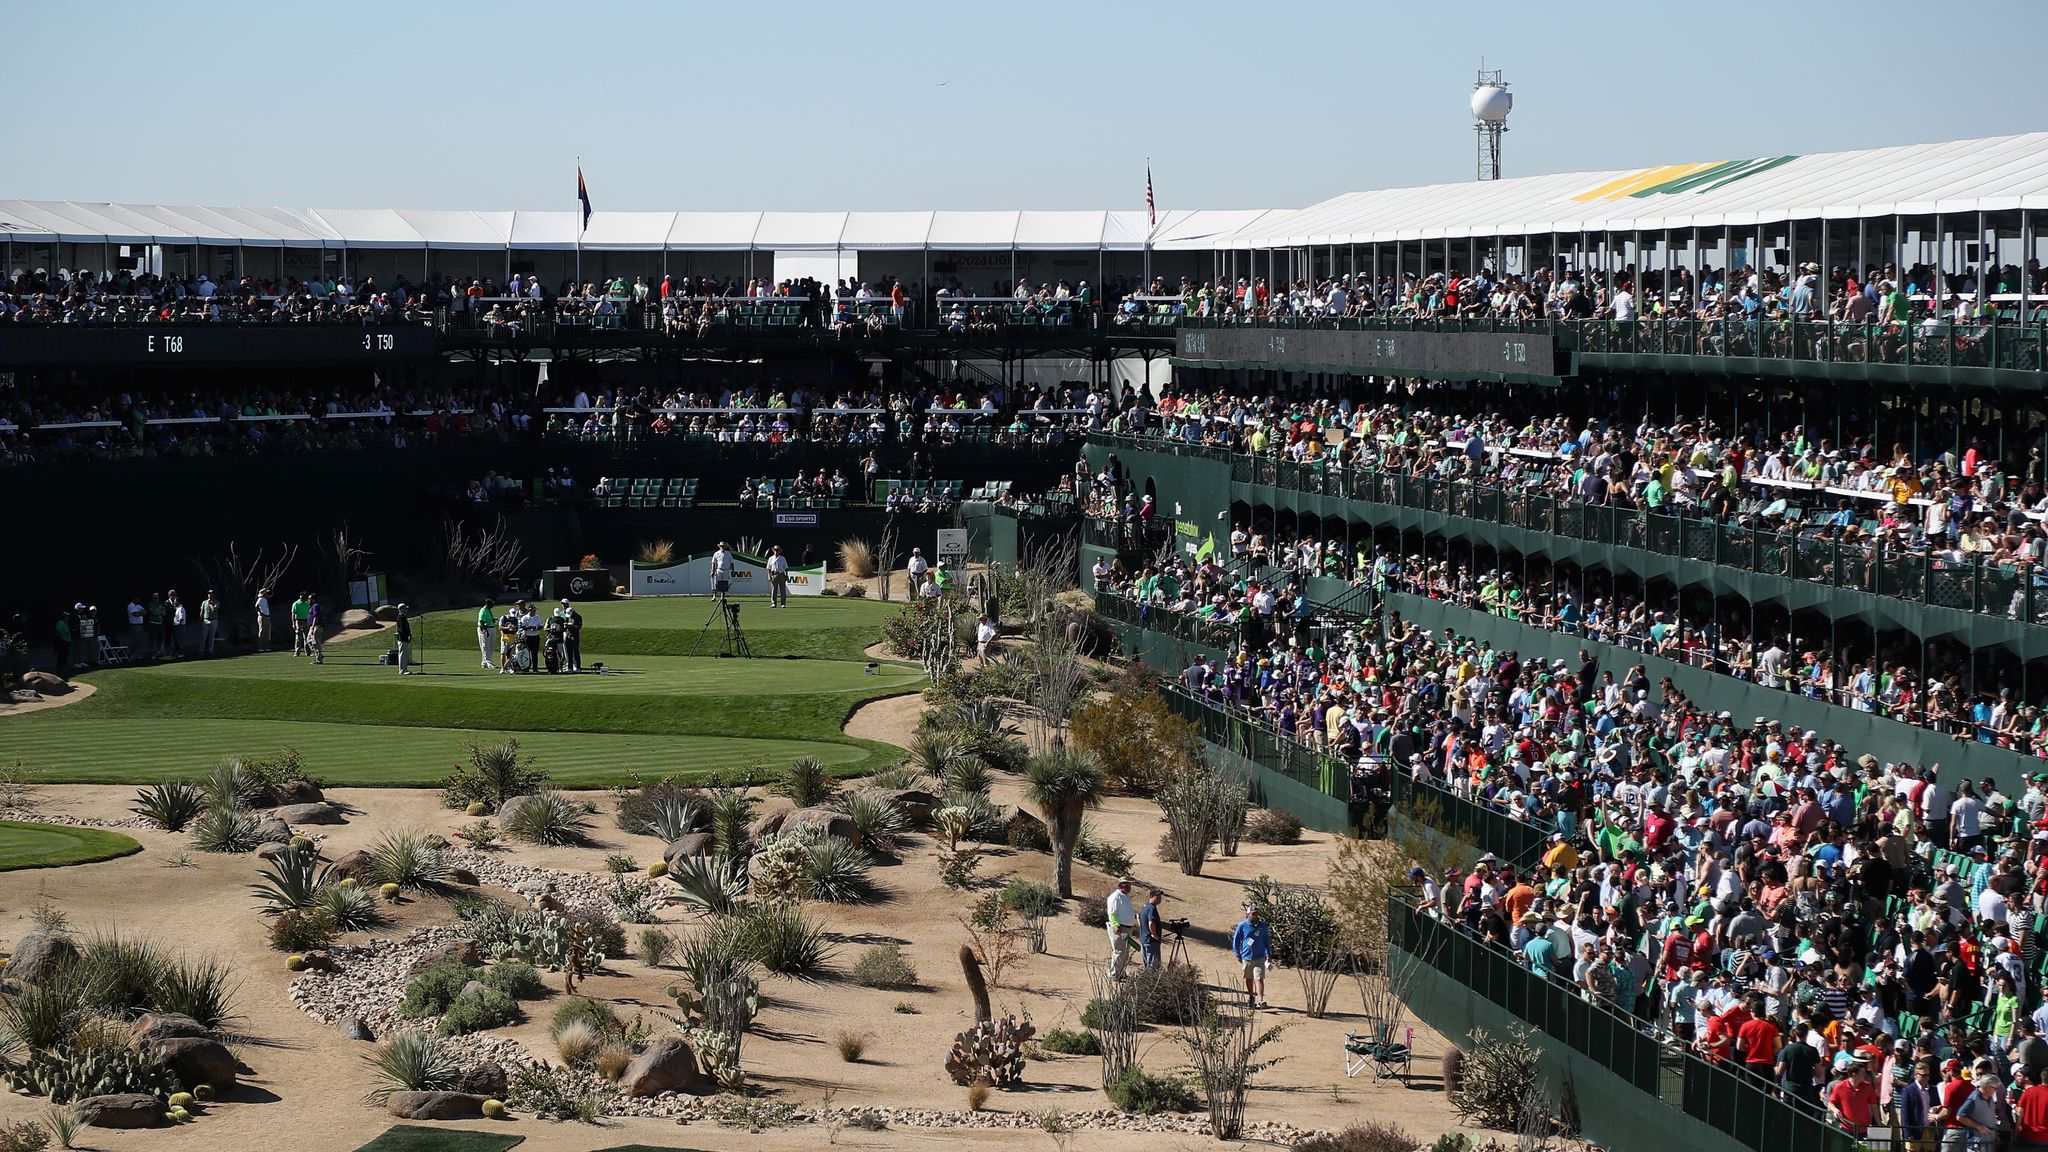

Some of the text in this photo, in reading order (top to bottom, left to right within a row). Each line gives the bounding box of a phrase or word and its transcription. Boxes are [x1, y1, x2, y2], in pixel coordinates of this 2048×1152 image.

[148, 335, 183, 353] E T68
[361, 334, 394, 350] -3 T50
[940, 556, 952, 565] 16
[787, 576, 809, 584] WM
